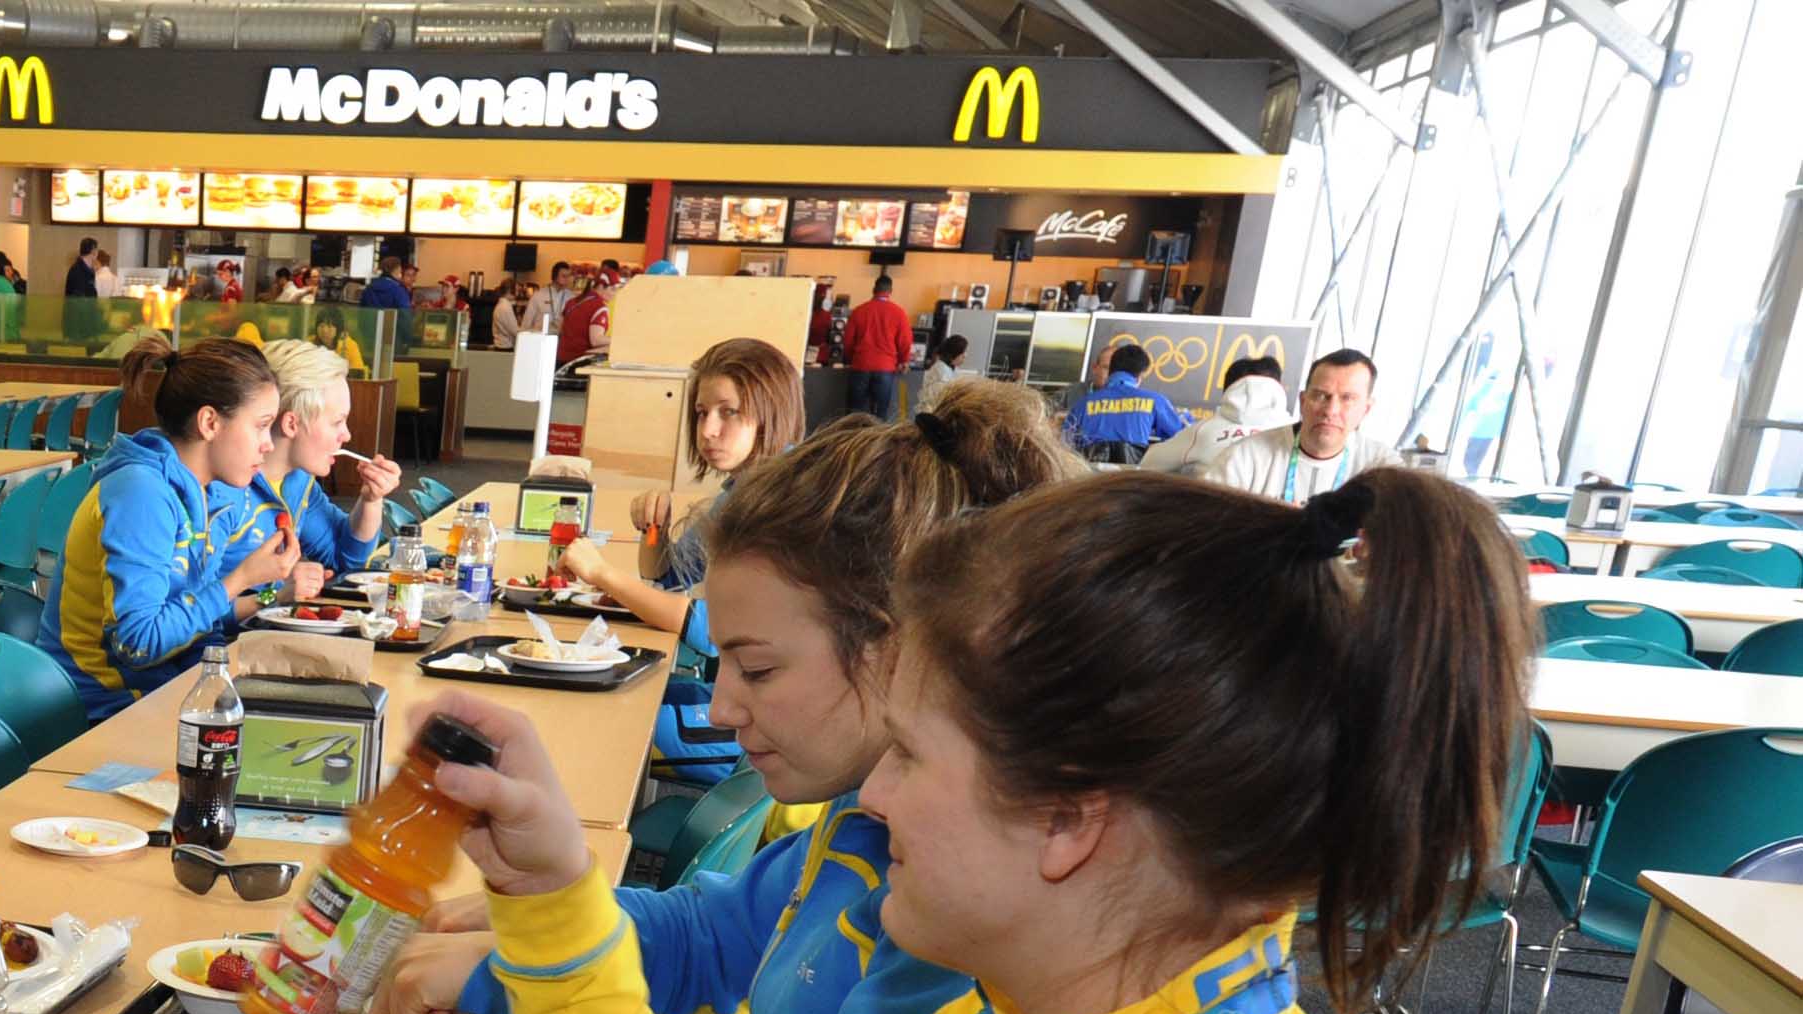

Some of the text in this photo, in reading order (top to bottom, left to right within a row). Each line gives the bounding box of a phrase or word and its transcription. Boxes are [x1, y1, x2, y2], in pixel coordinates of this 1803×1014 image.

[260, 66, 659, 130] McDonald's
[1035, 209, 1128, 243] McCafé
[1086, 397, 1155, 415] KAZAKHSTAN
